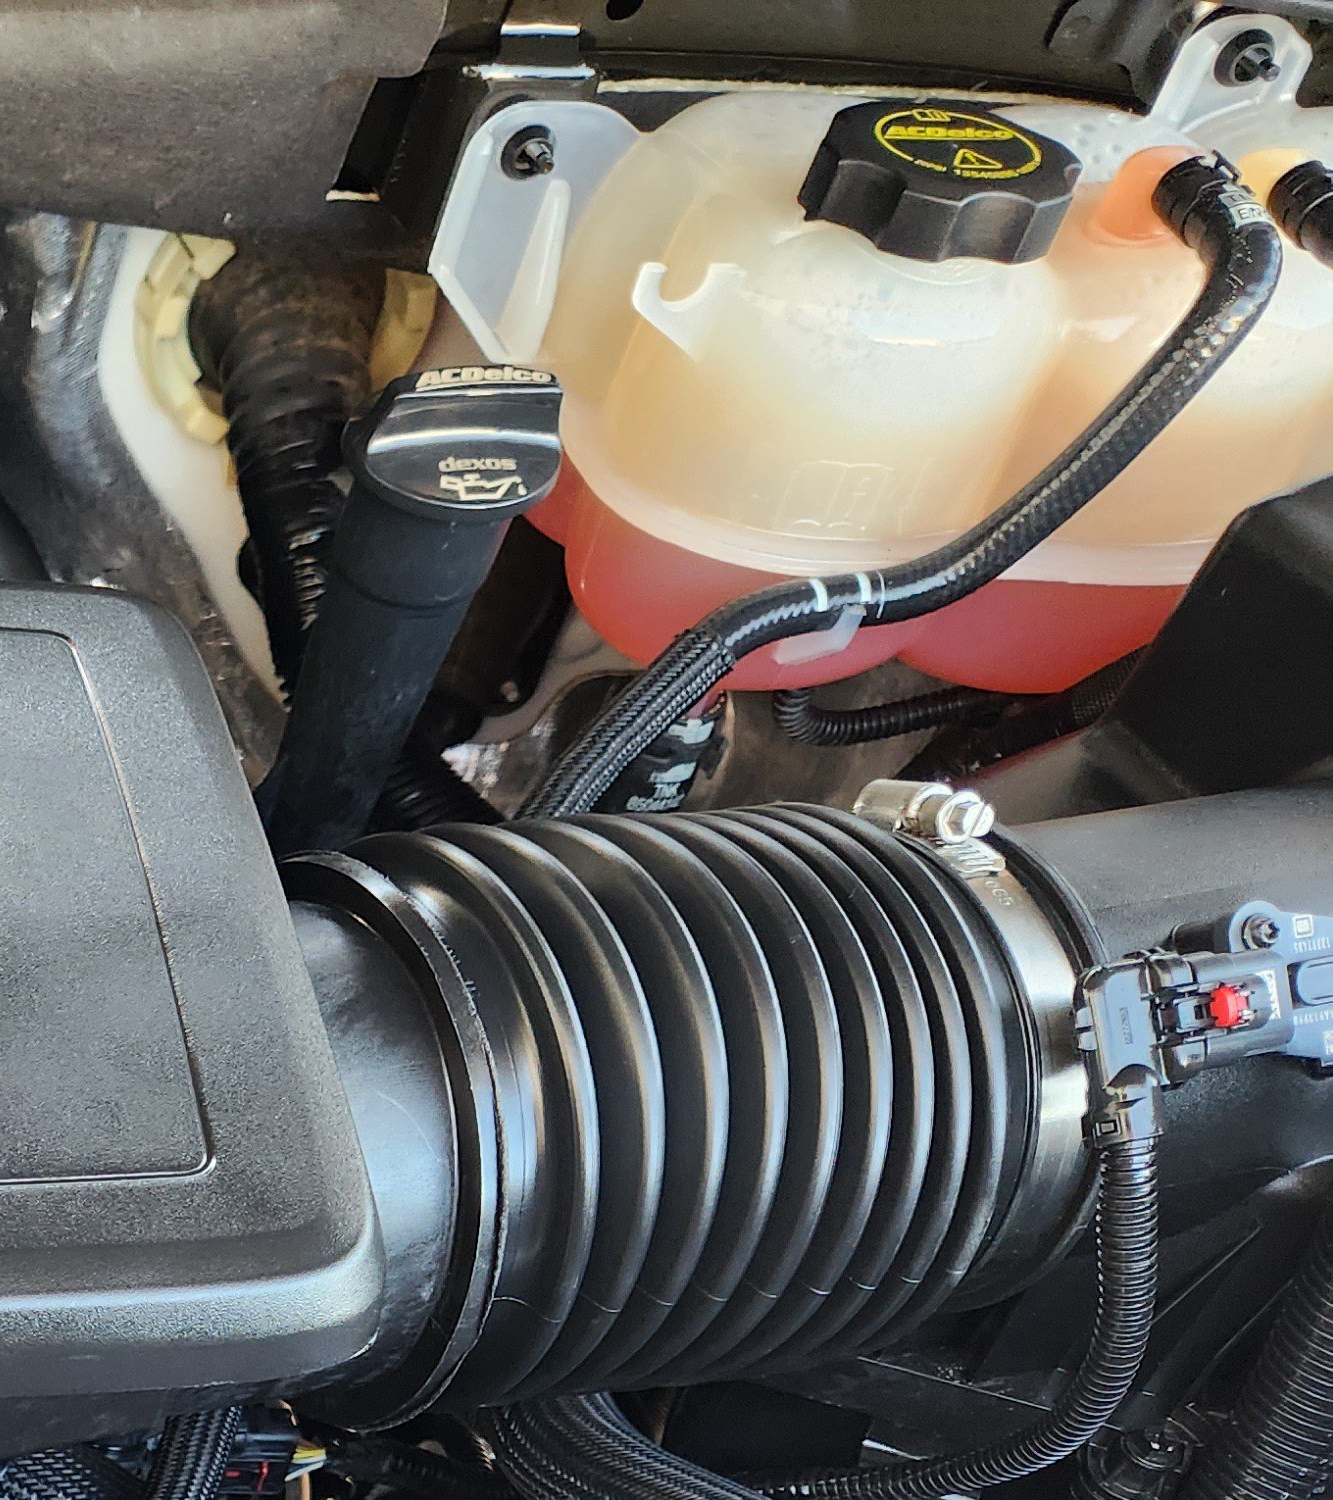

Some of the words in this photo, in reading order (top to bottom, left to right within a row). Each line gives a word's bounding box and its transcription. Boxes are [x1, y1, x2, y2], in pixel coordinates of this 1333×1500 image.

[884, 125, 1014, 141] ACDelco
[415, 366, 553, 390] ACDelco
[438, 456, 517, 472] dexos
